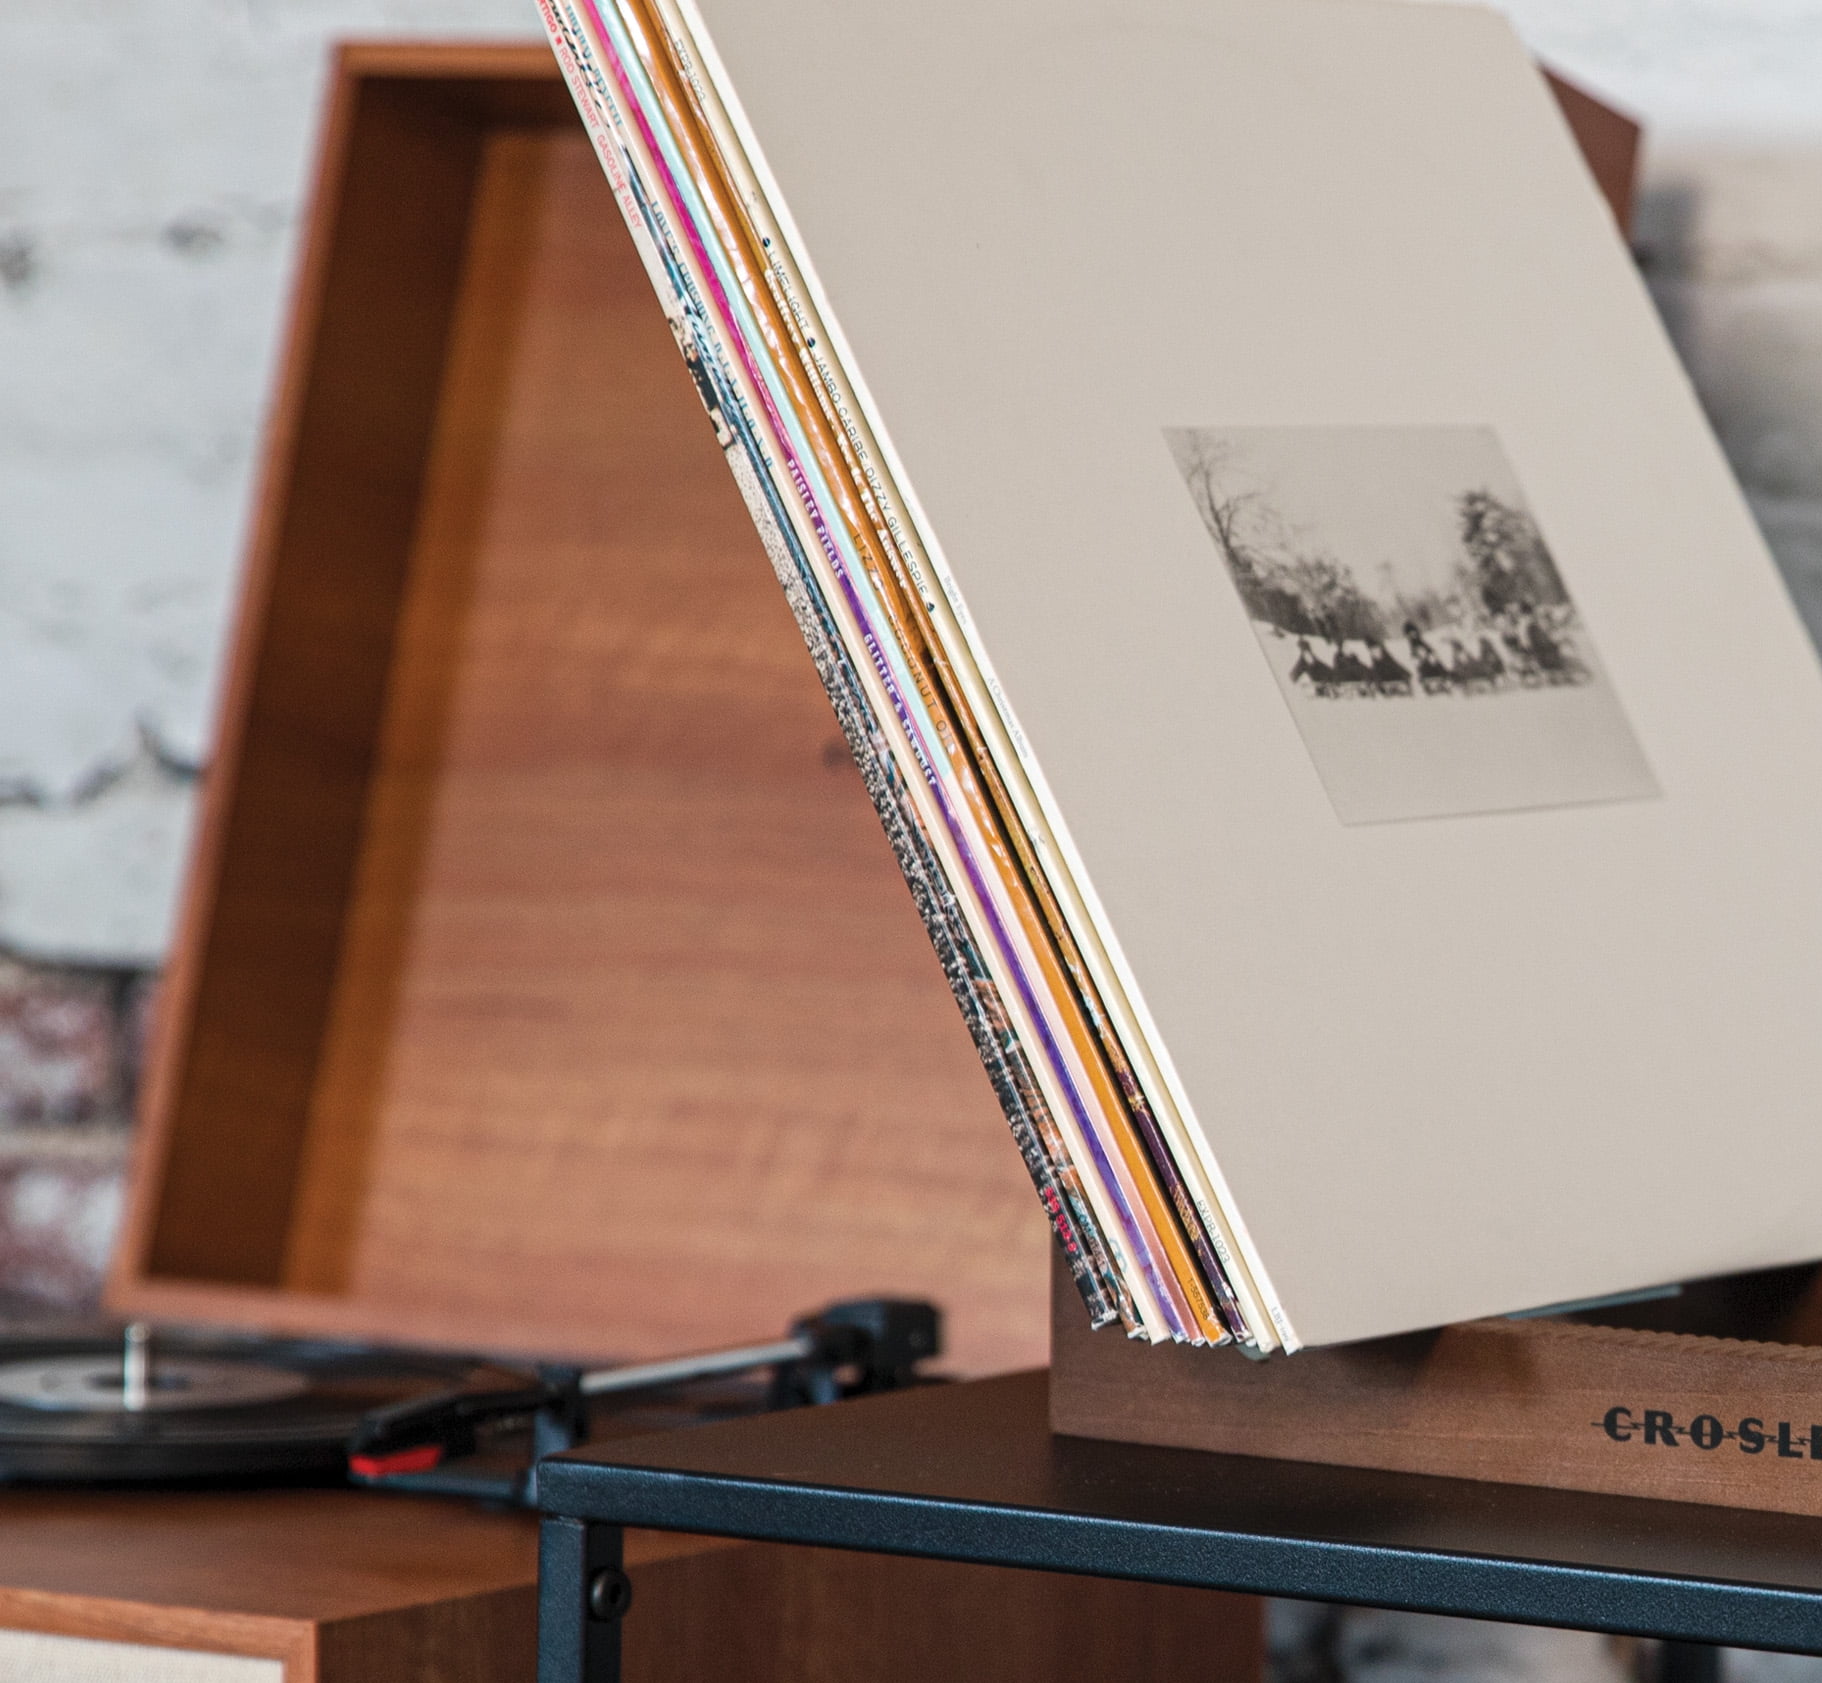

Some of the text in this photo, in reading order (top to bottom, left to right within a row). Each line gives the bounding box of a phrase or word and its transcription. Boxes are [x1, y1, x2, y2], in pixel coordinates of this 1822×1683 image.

[558, 46, 577, 74] ROD
[570, 75, 599, 129] STEWART
[594, 133, 627, 191] GASOLINE
[621, 194, 642, 229] ALLEY
[766, 250, 809, 331] LIMELIGHT
[812, 351, 842, 405] JAMBO
[886, 515, 928, 595] GILLESPIE
[785, 458, 818, 519] PAISLEY
[815, 525, 844, 579] FIELDS
[861, 632, 896, 694] GLITTER
[900, 718, 936, 785] SAWDUST
